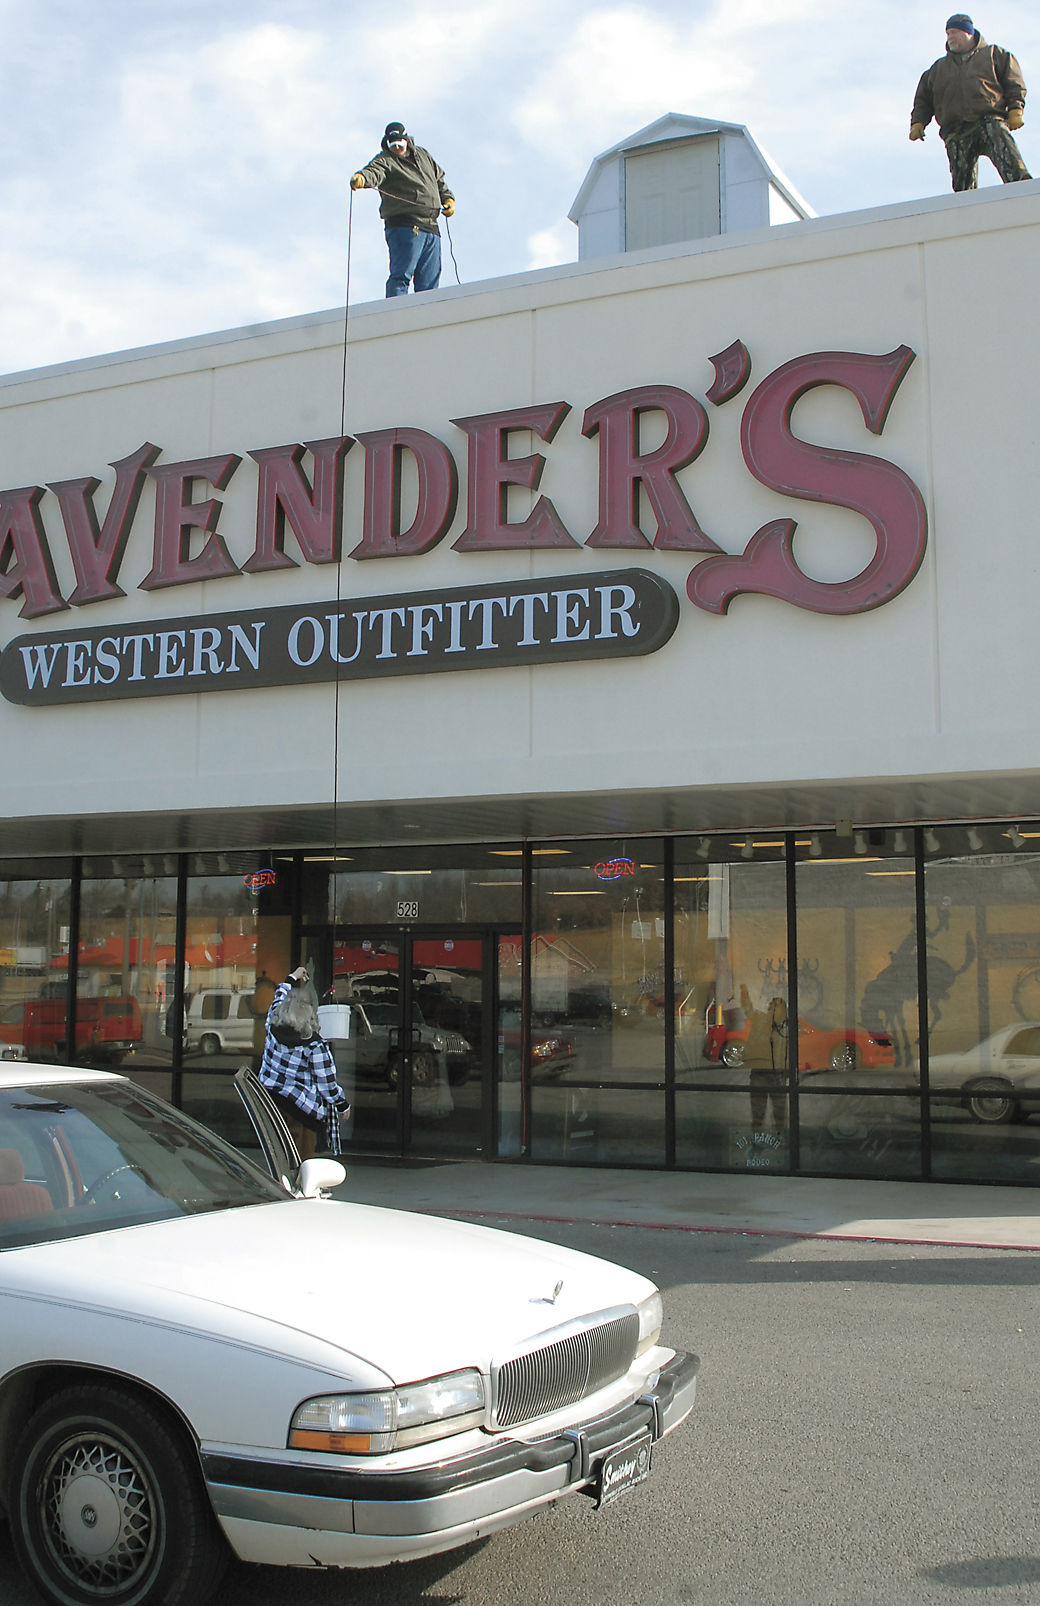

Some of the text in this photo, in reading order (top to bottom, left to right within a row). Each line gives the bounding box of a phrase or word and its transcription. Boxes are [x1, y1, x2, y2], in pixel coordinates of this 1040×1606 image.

[0, 338, 928, 619] AVENDER'S
[18, 584, 642, 690] WESTERN OUTFITTER
[593, 862, 636, 876] OPEN
[243, 872, 277, 886] OPEN
[397, 902, 418, 917] 528
